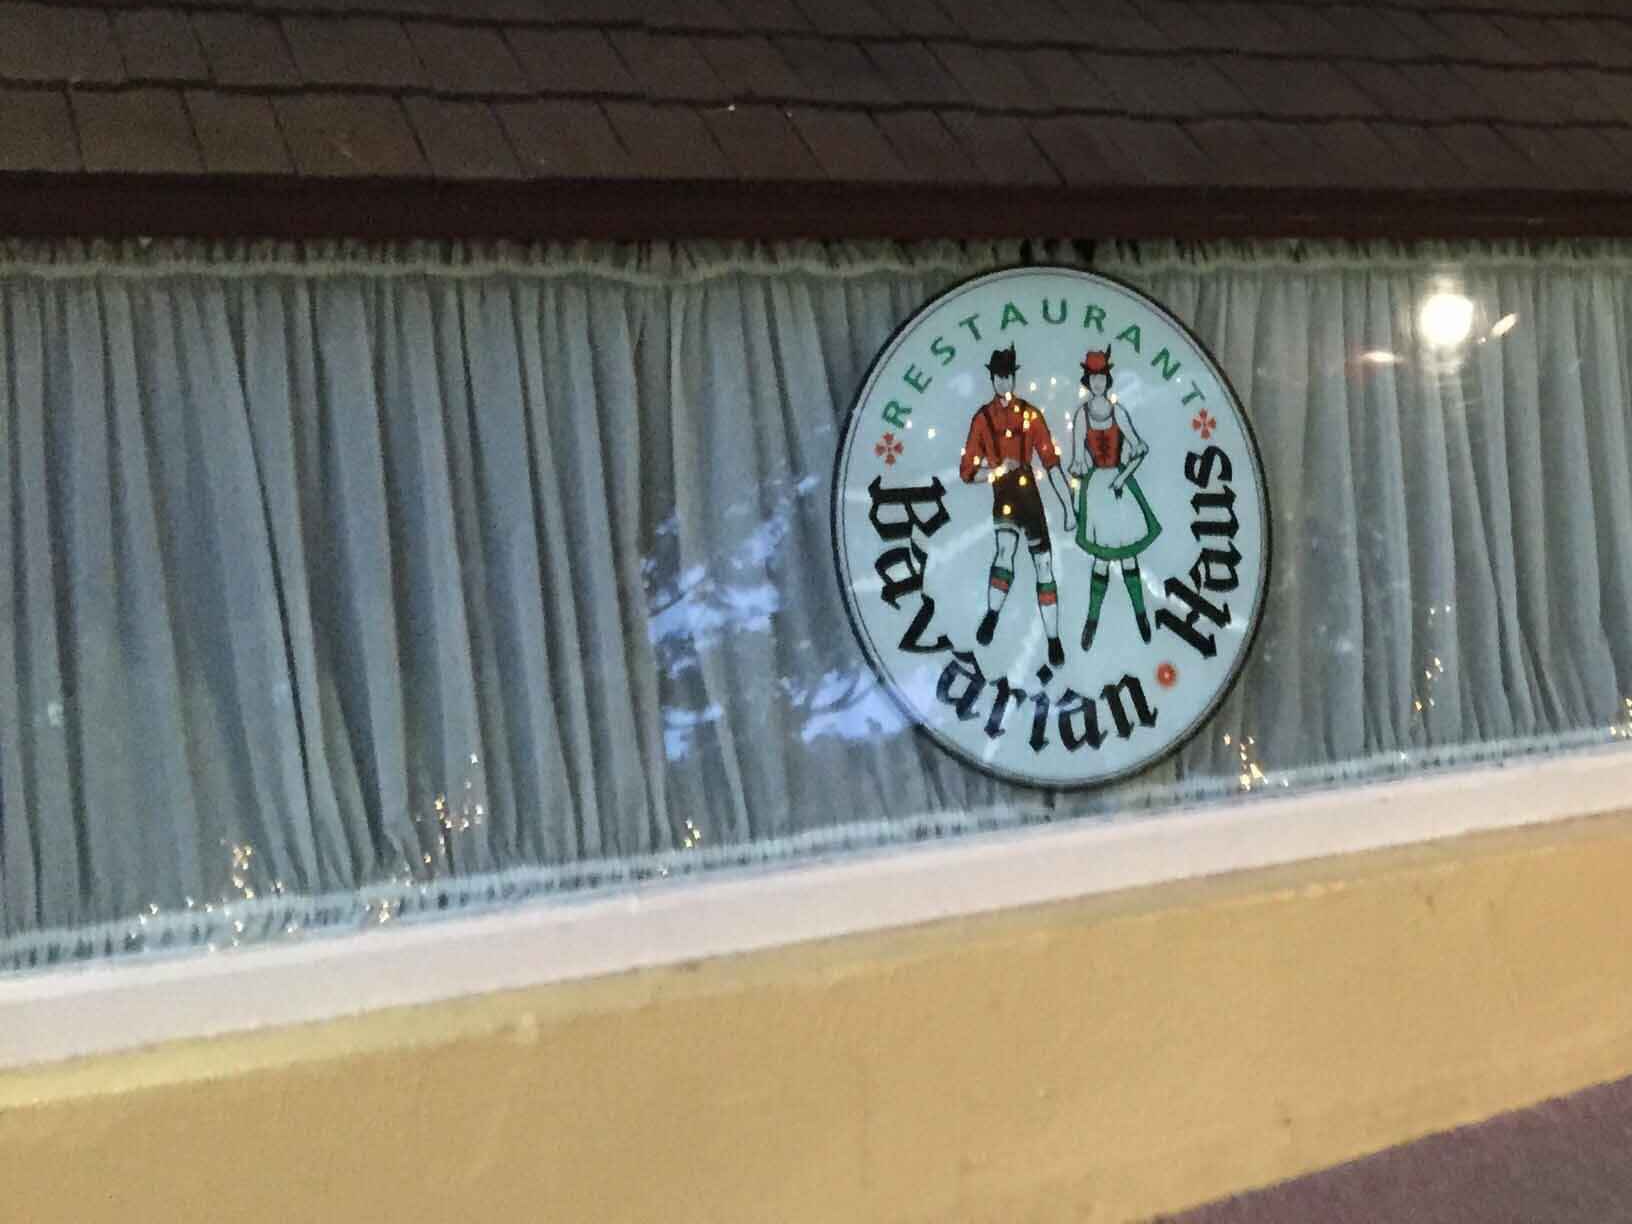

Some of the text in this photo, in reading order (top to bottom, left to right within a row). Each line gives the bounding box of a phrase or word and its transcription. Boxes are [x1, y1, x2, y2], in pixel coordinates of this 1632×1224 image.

[882, 298, 1205, 429] RESTAURANT
[868, 445, 1243, 753] Bavarian Haus
